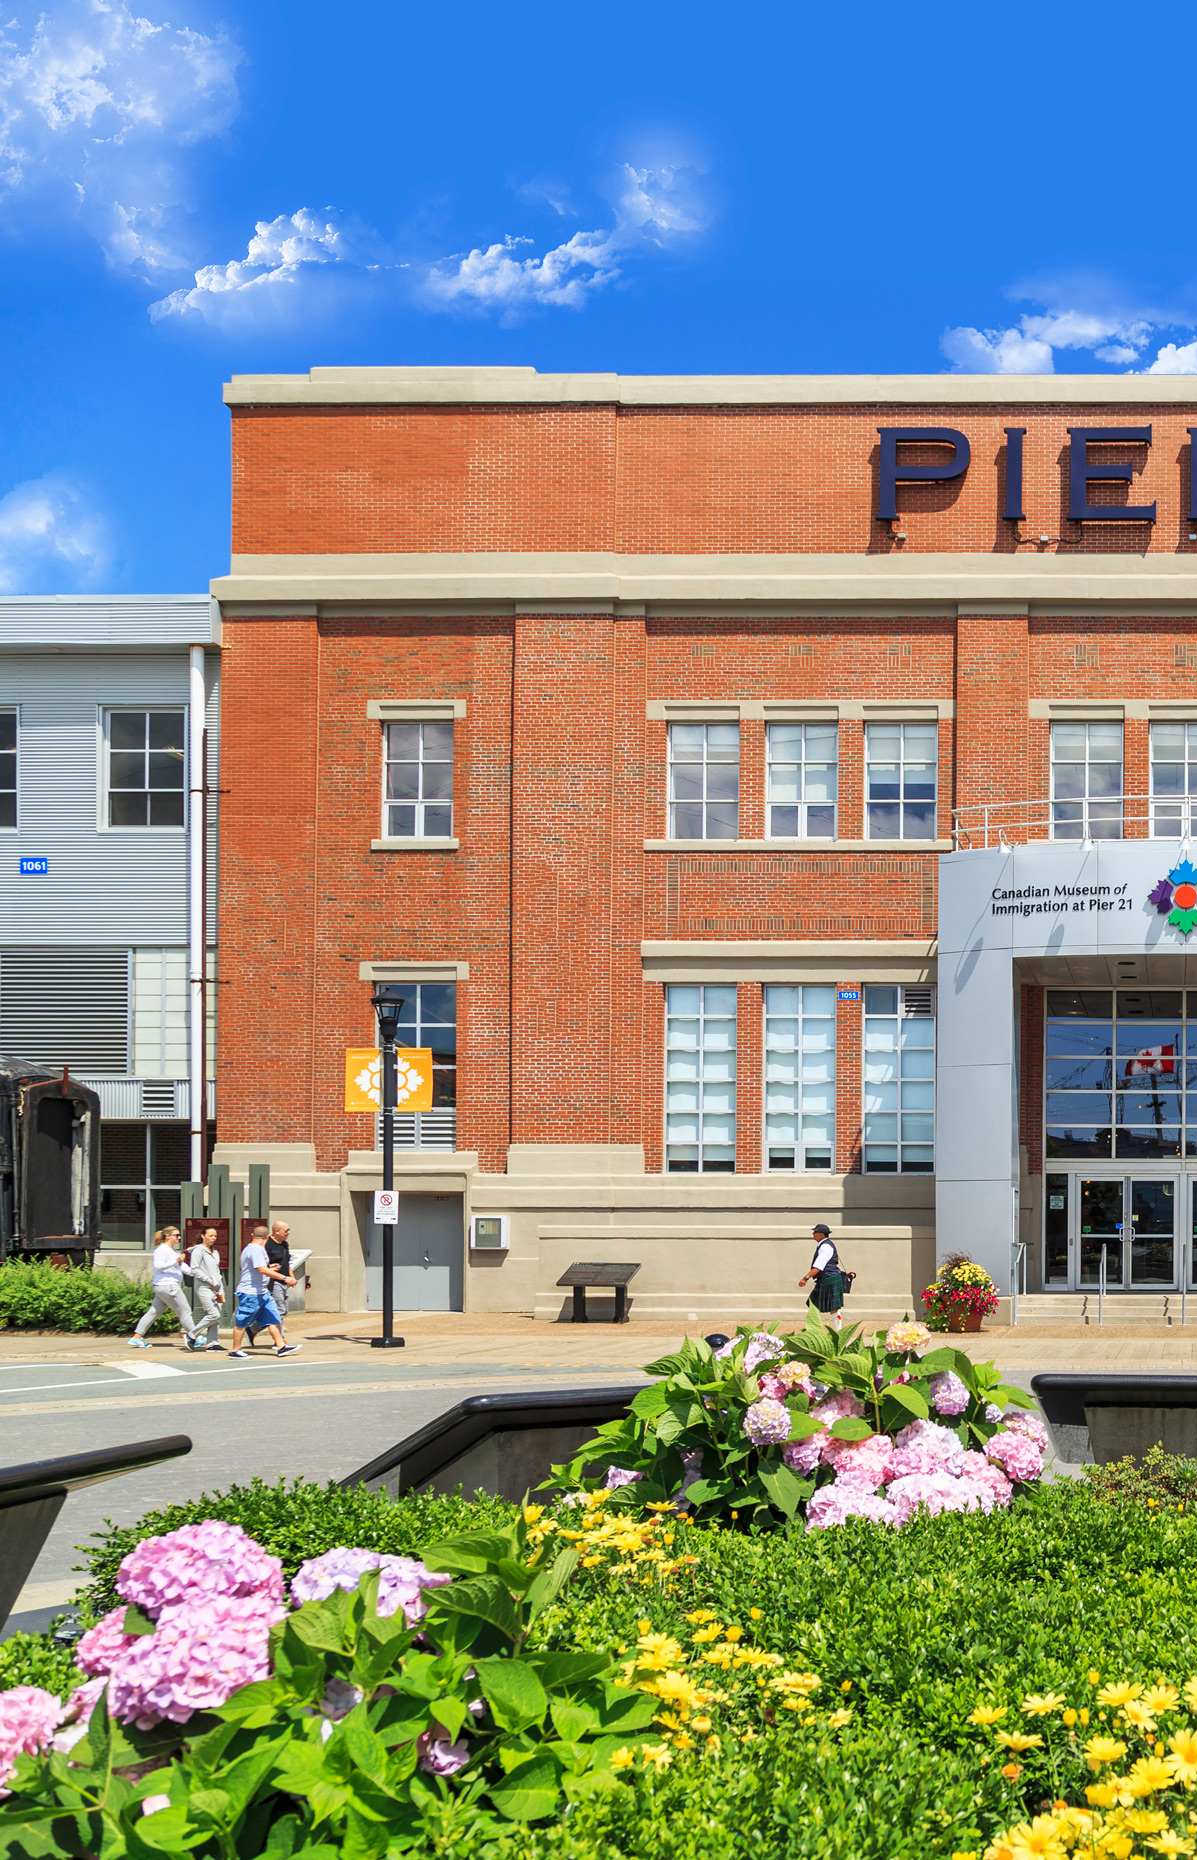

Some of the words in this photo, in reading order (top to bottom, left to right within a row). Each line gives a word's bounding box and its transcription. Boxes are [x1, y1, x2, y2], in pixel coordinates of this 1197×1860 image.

[22, 861, 46, 871] 1061
[991, 885, 1050, 900] Canadian
[1053, 884, 1111, 897] Museum
[1113, 882, 1128, 895] of
[991, 899, 1069, 917] Immigration
[1072, 899, 1085, 912] at
[1089, 898, 1115, 911] Pier
[1118, 898, 1133, 911] 21
